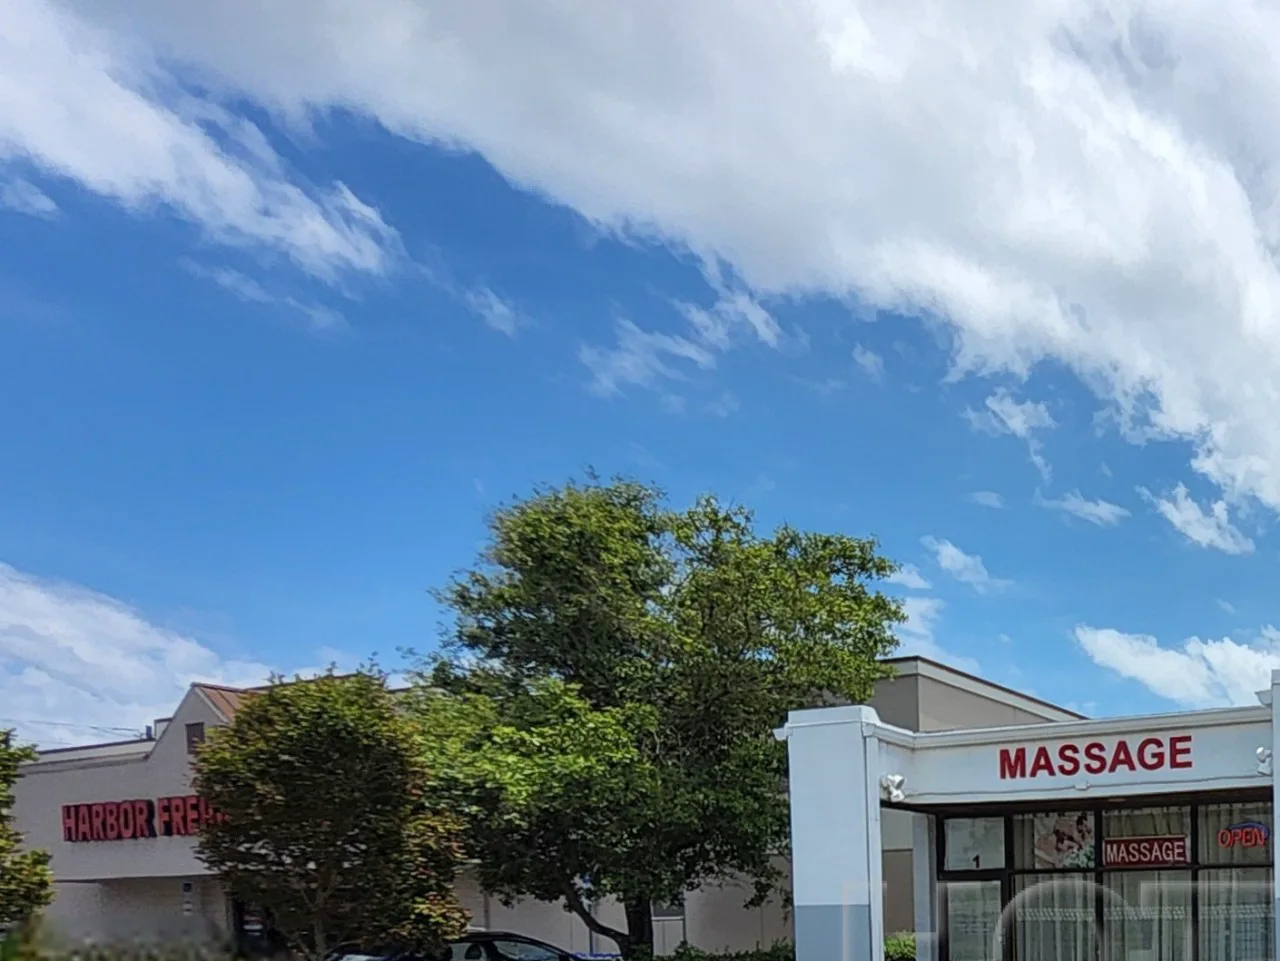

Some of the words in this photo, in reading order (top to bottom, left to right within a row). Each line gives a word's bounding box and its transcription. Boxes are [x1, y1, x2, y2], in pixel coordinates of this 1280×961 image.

[999, 735, 1193, 780] MASSAGE
[61, 800, 155, 842] HARBOR
[1217, 829, 1265, 849] OPEN
[972, 855, 981, 869] 1
[1106, 841, 1185, 863] MASSAGE
